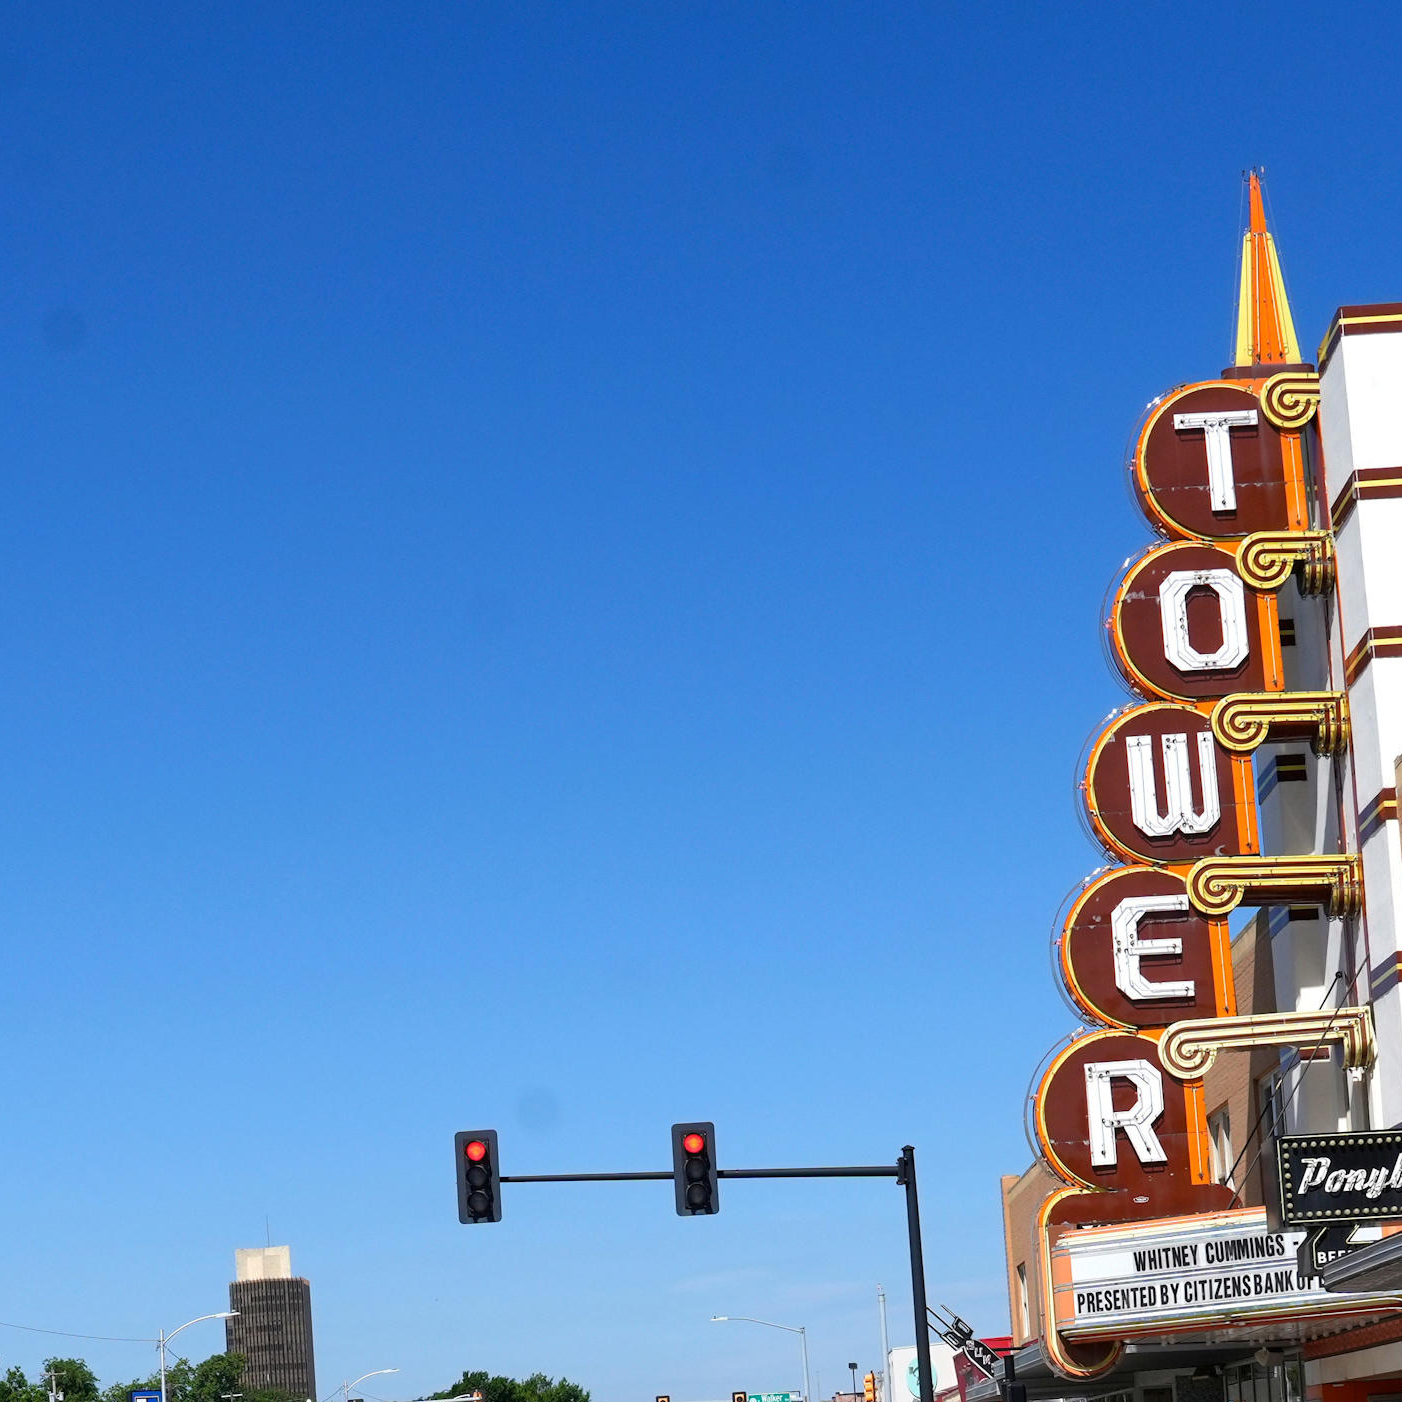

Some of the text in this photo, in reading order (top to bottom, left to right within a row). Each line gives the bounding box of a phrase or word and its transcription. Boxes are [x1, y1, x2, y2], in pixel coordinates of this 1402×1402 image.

[1084, 409, 1259, 1166] TOWER
[1134, 1244, 1197, 1273] WHITNEY
[1205, 1235, 1285, 1265] CUMMINGS
[1076, 1286, 1158, 1314] PRESENTED
[1161, 1283, 1181, 1304] BY
[1184, 1275, 1251, 1304] CITIZENS
[1254, 1270, 1295, 1296] BANK
[761, 1393, 783, 1402] Walker
